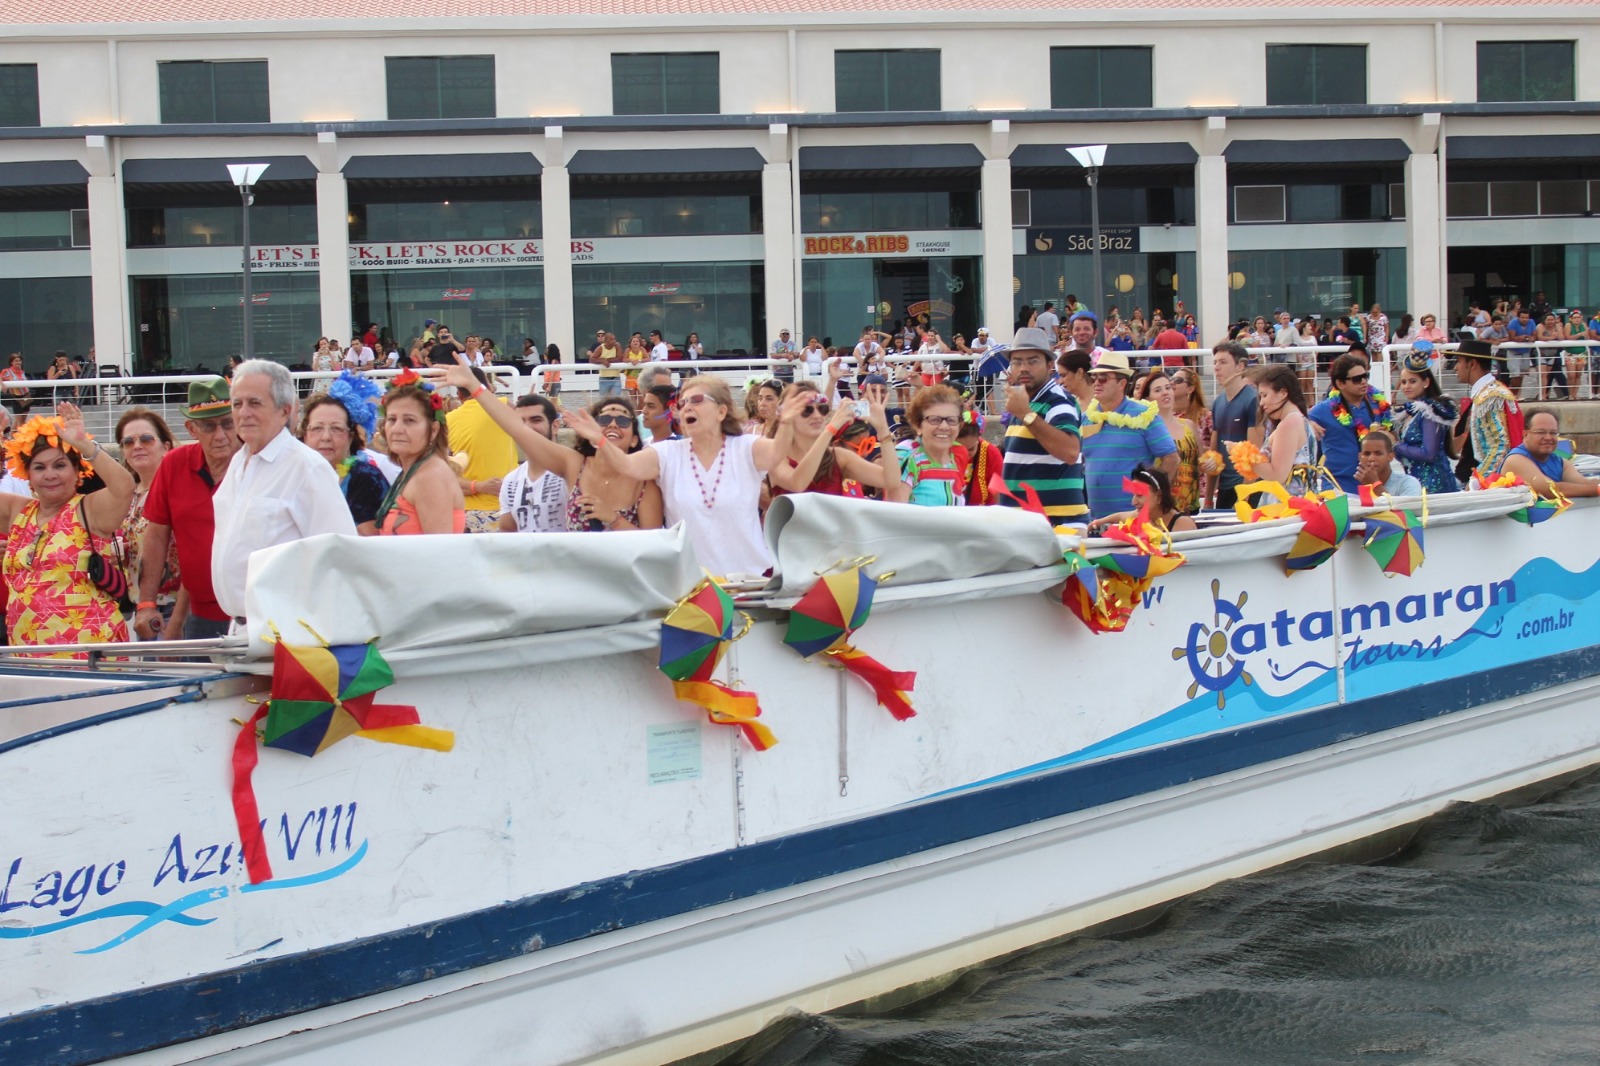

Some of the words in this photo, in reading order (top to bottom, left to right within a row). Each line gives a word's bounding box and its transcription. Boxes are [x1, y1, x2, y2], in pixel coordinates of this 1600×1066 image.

[243, 247, 304, 261] ET'S
[386, 244, 447, 258] LET'S
[453, 243, 516, 257] ROCK
[522, 242, 539, 254] &
[1068, 234, 1094, 250] São
[1098, 234, 1132, 250] Braz
[458, 257, 475, 265] BAR
[1186, 578, 1516, 692] Catamaran
[1517, 608, 1575, 640] .com.br
[1343, 634, 1449, 671] tours
[0, 857, 126, 917] Lago
